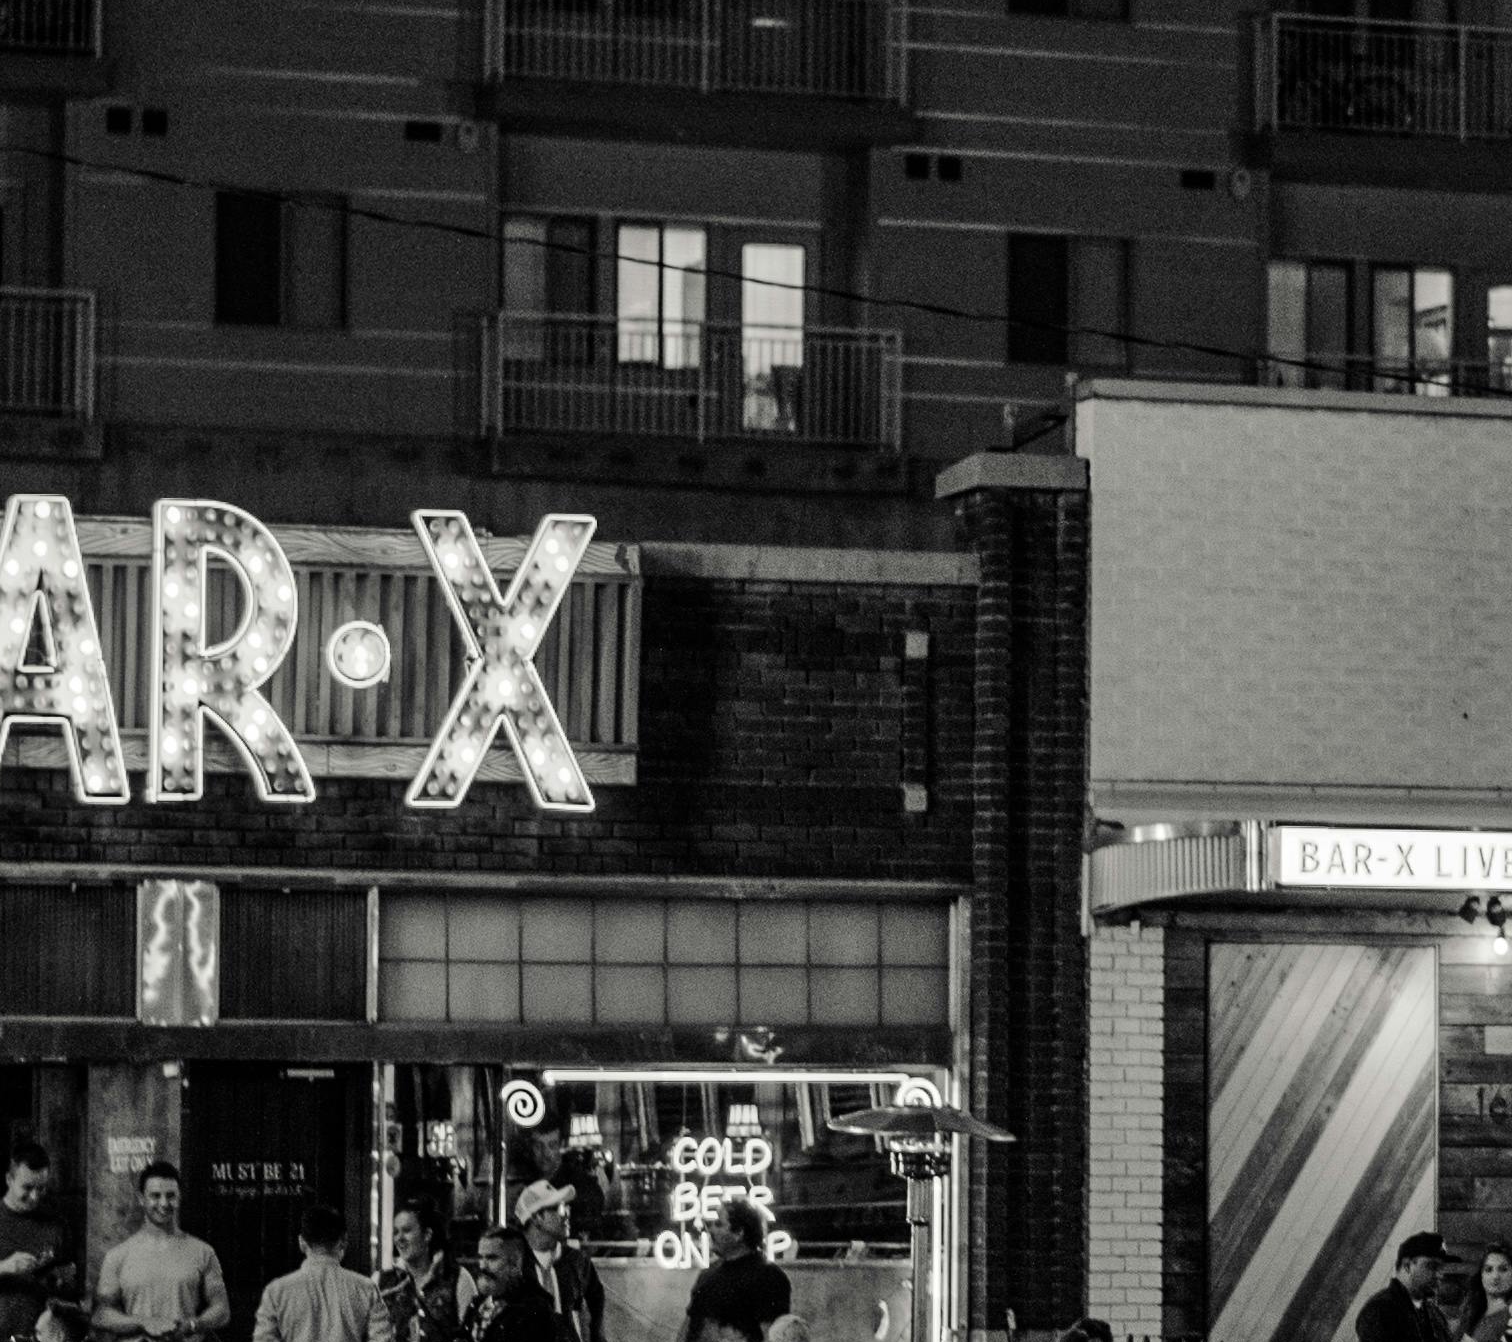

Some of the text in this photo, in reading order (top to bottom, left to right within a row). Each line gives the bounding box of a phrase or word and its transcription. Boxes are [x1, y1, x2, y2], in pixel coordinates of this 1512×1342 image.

[1299, 841, 1415, 877] BAR-X
[672, 1136, 773, 1175] COLD
[654, 1230, 710, 1270] ON
